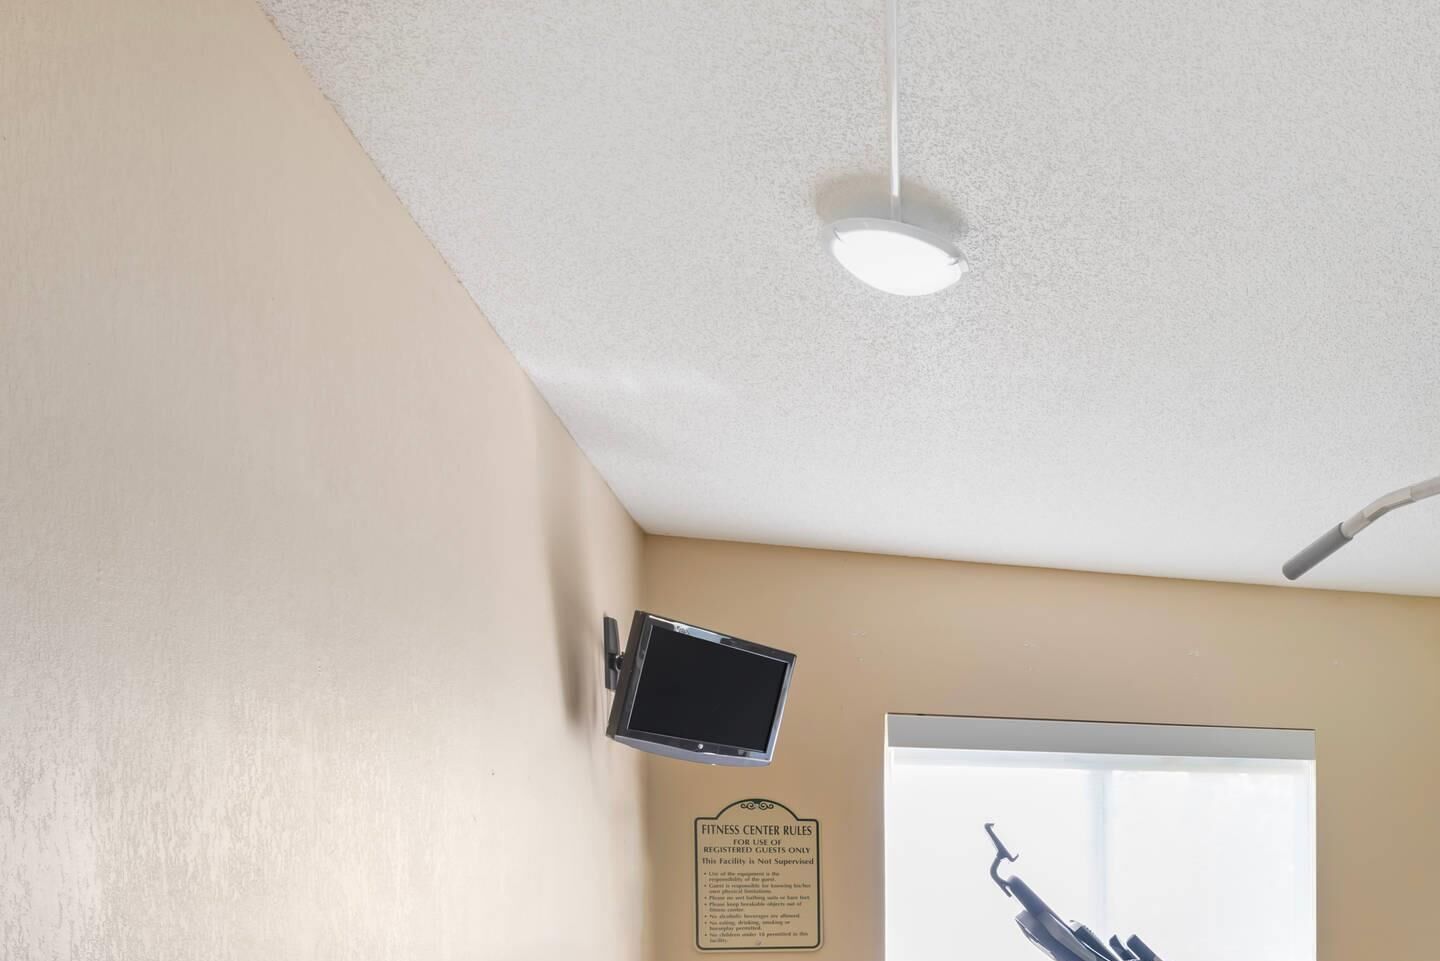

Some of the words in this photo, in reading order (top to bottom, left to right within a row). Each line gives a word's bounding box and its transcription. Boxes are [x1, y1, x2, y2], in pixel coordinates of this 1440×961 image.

[702, 825, 739, 835] FITNESS
[743, 825, 780, 835] CENTER
[784, 826, 812, 835] RULES
[774, 858, 814, 866] Supervised
